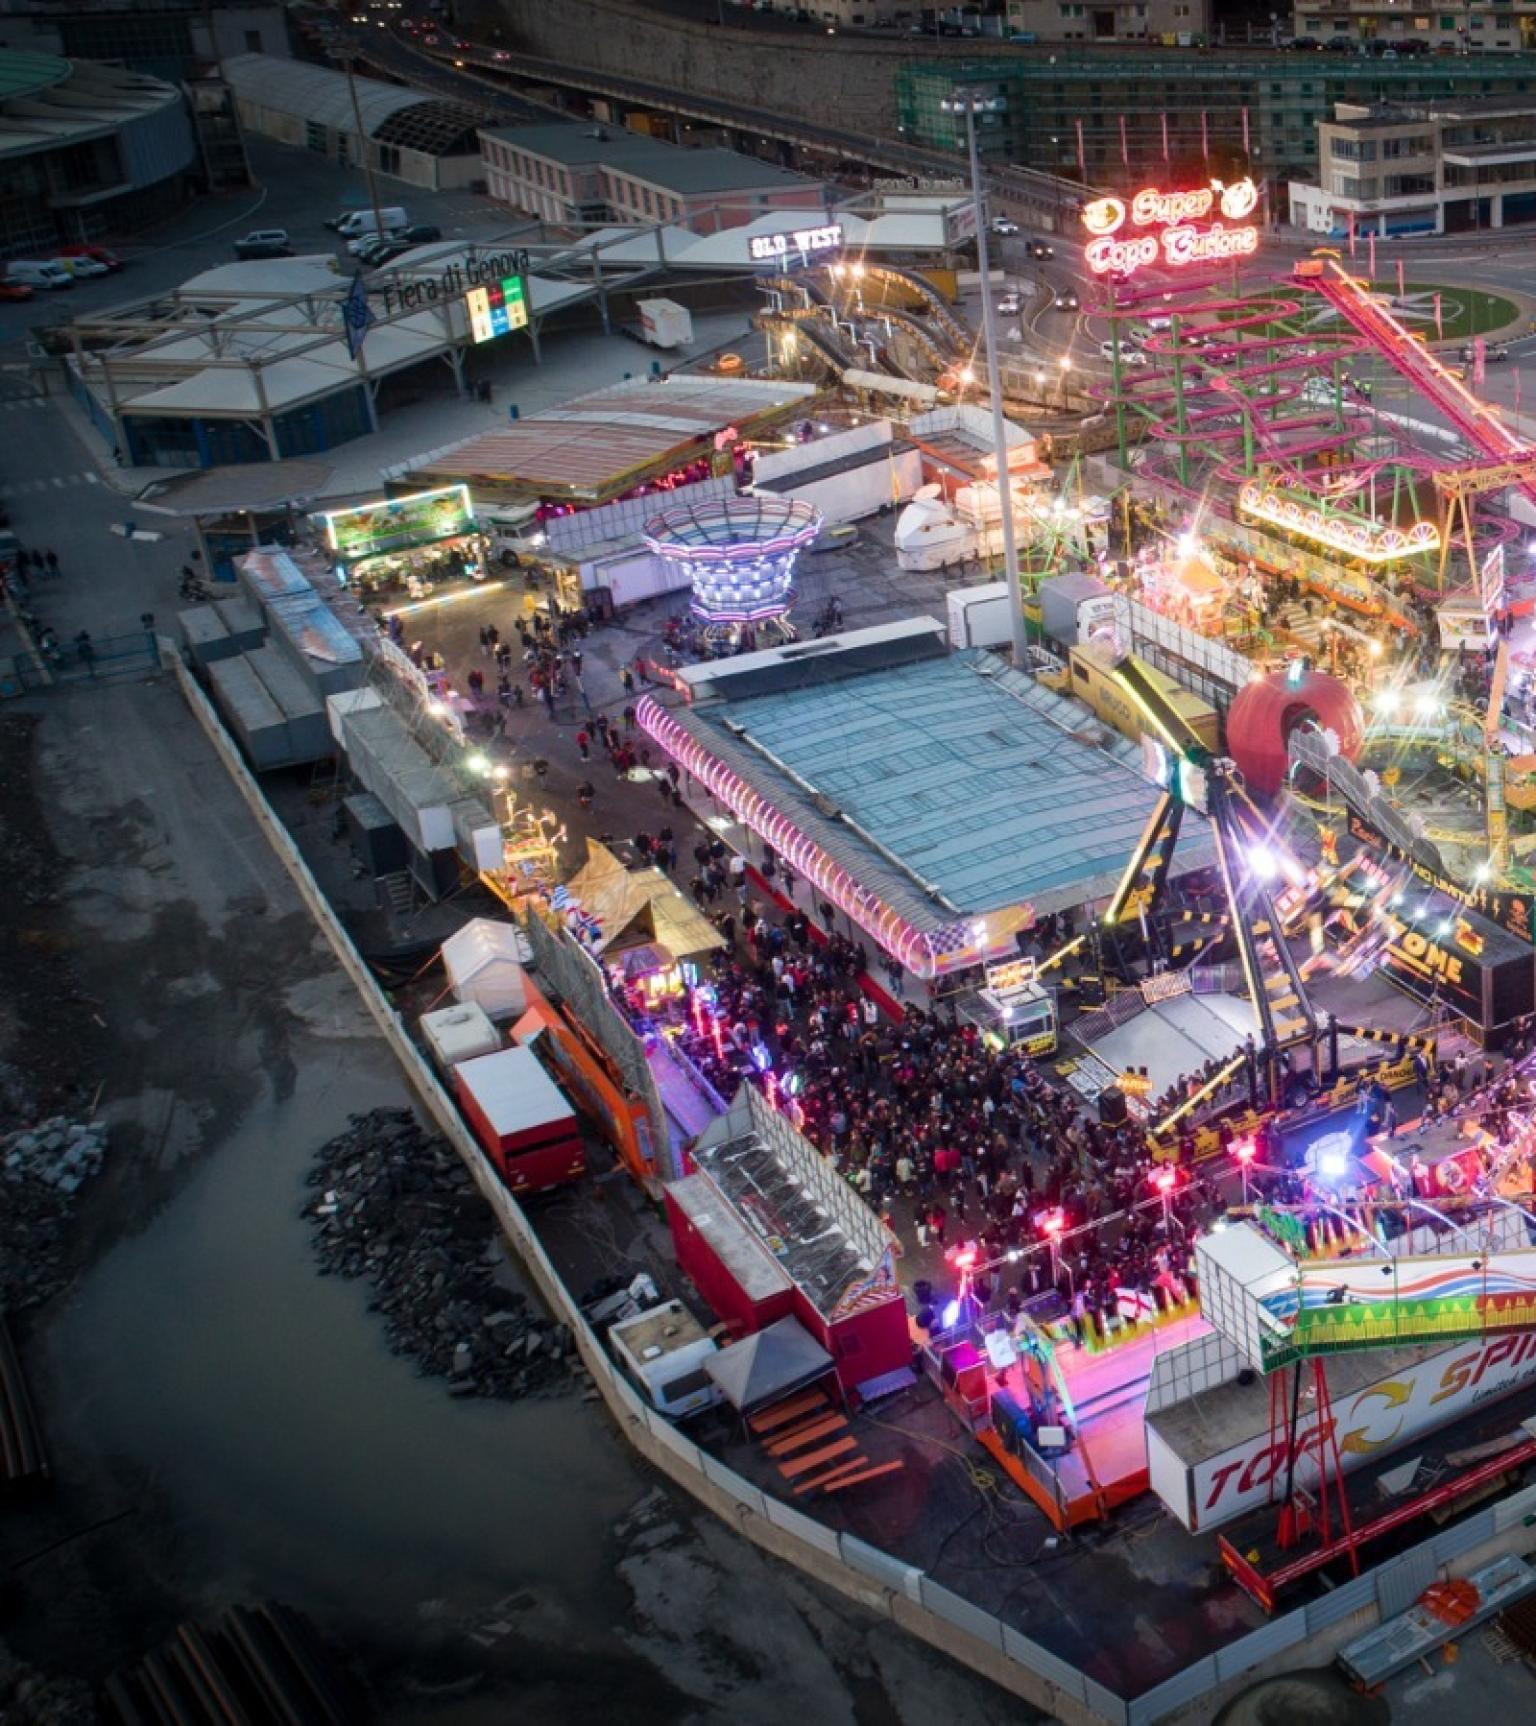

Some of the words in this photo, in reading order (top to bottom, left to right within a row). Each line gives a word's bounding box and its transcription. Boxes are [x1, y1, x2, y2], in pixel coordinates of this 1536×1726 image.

[1132, 188, 1213, 226] Super
[751, 234, 787, 259] OLD
[793, 225, 842, 251] WEST
[1161, 232, 1258, 265] Burlone
[383, 278, 437, 316] Fiera
[443, 261, 462, 293] di
[466, 249, 530, 285] Genova
[1206, 1418, 1339, 1510] TOP
